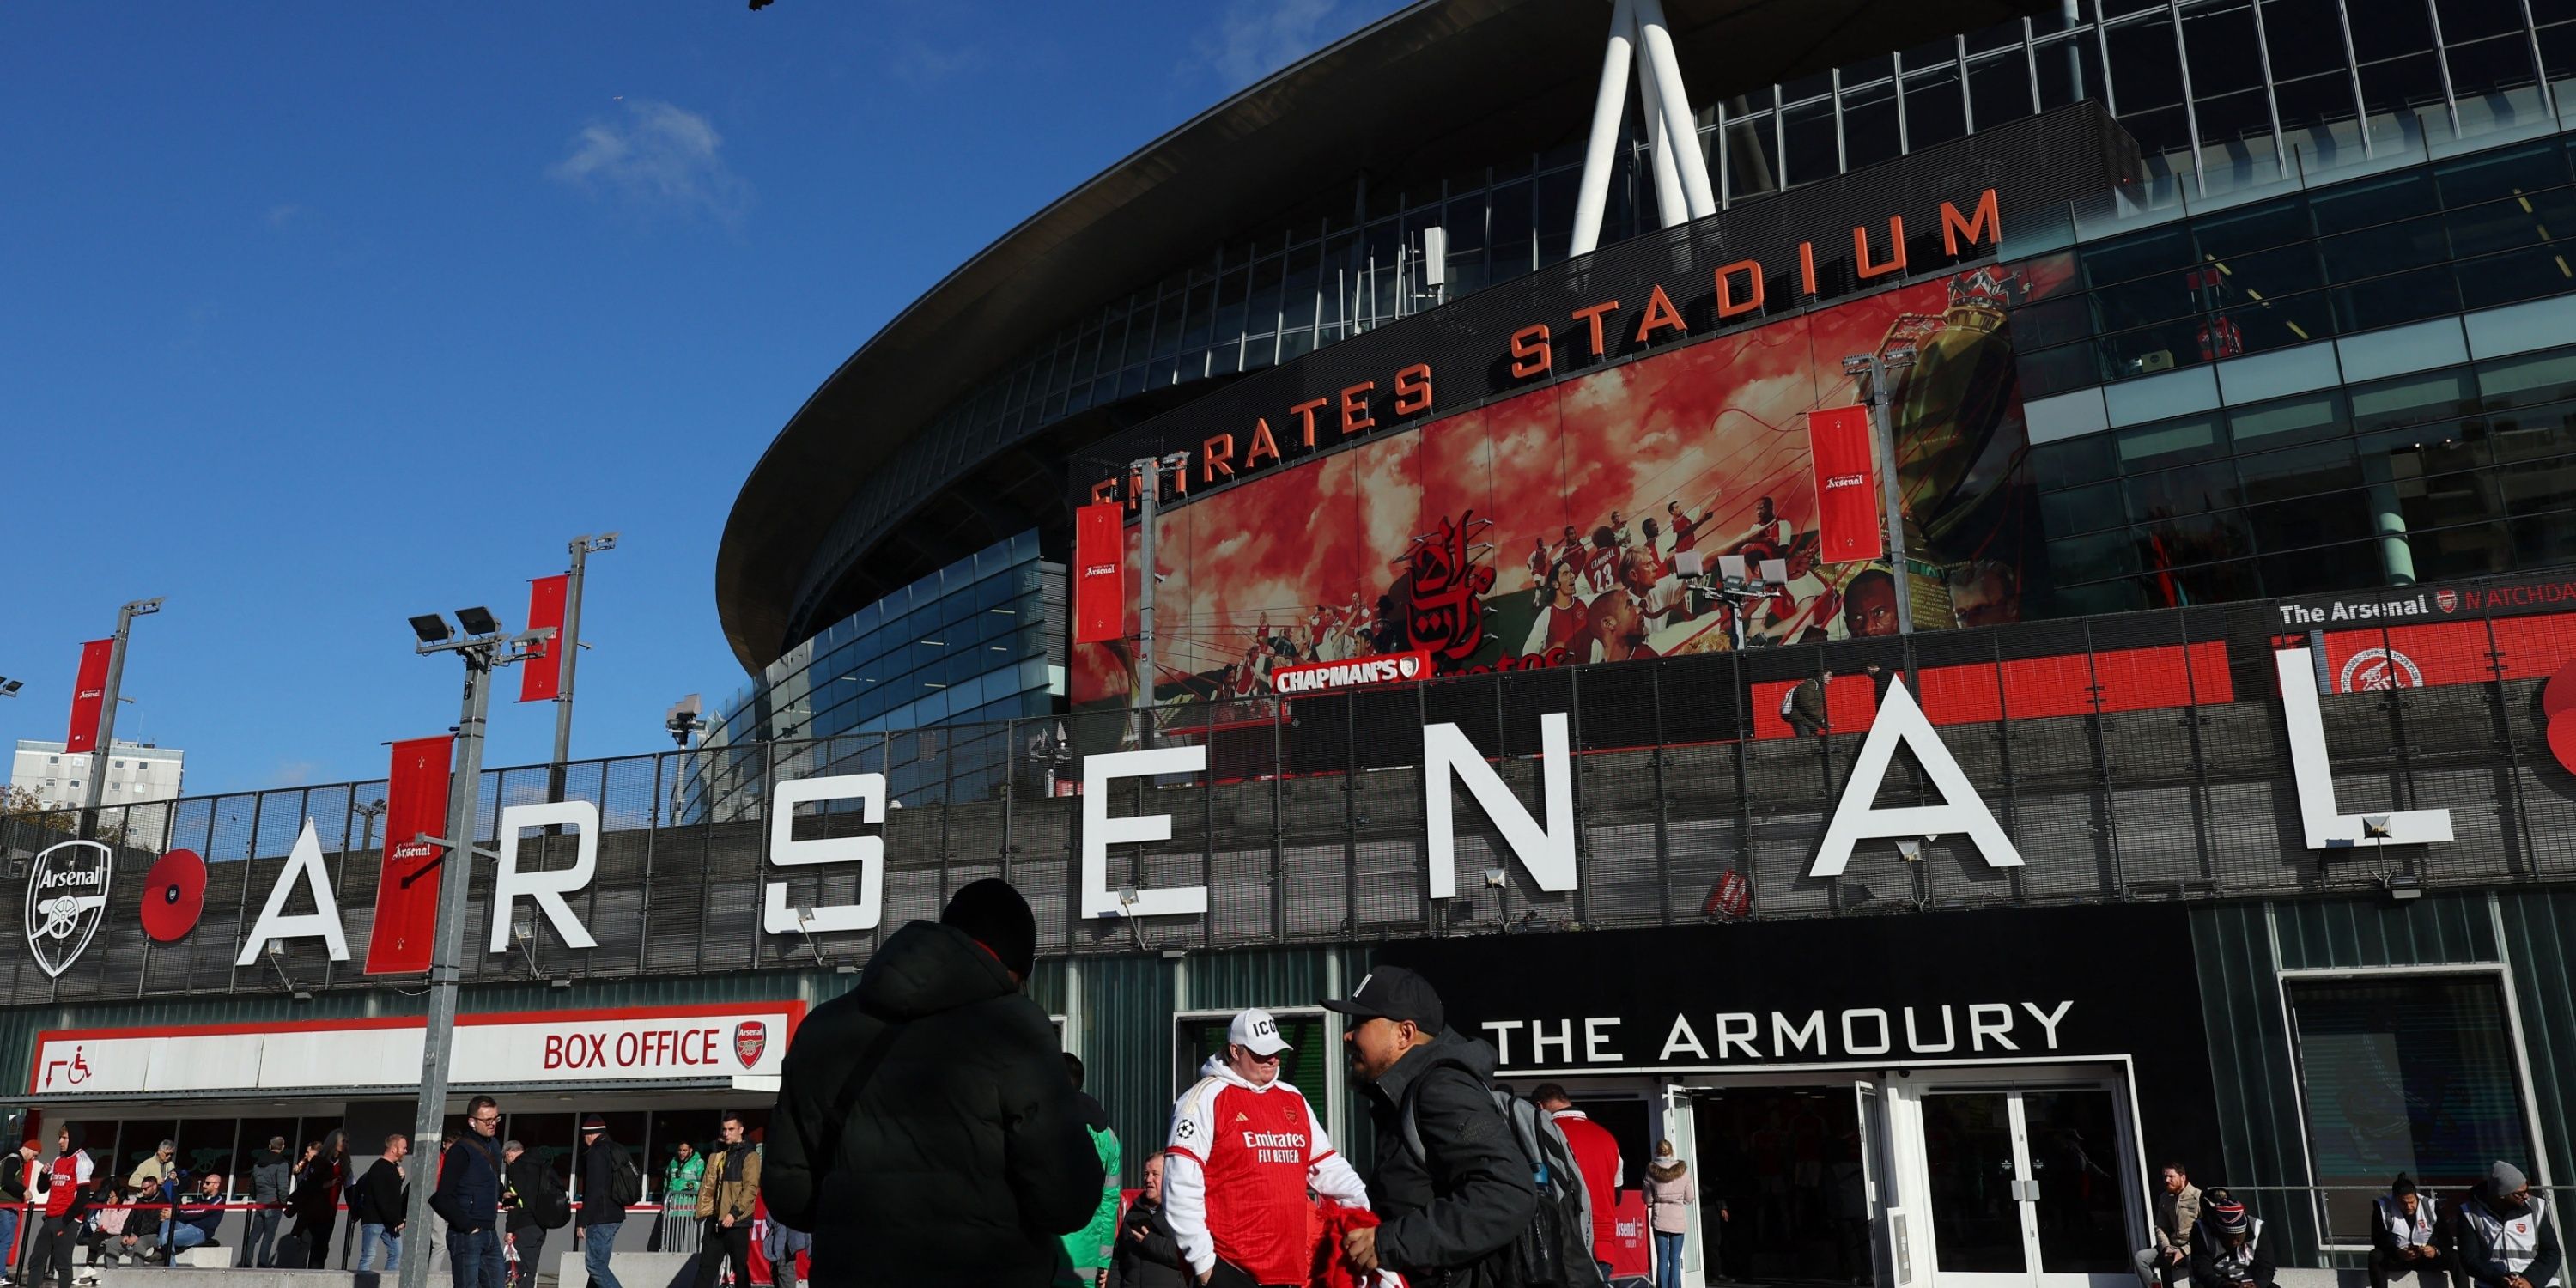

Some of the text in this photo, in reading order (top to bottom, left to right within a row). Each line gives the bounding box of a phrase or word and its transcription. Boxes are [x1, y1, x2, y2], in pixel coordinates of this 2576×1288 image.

[1510, 188, 2001, 378] STADIUM
[1826, 474, 1863, 490] Arsenal
[1084, 563, 1115, 577] Arsenal
[1594, 562, 1614, 592] 23
[2280, 582, 2576, 624] The Arsenal MATCHDA
[1276, 659, 1398, 694] CHAPMAN'S
[236, 647, 2454, 965] ARSENAL
[392, 843, 430, 860] Arsenal
[39, 866, 100, 889] Arsenal
[1481, 999, 2075, 1065] THE ARMOURY
[544, 1029, 720, 1070] BOX OFFICE
[1242, 1130, 1306, 1148] Emirates
[1258, 1149, 1299, 1163] FLY BETTER
